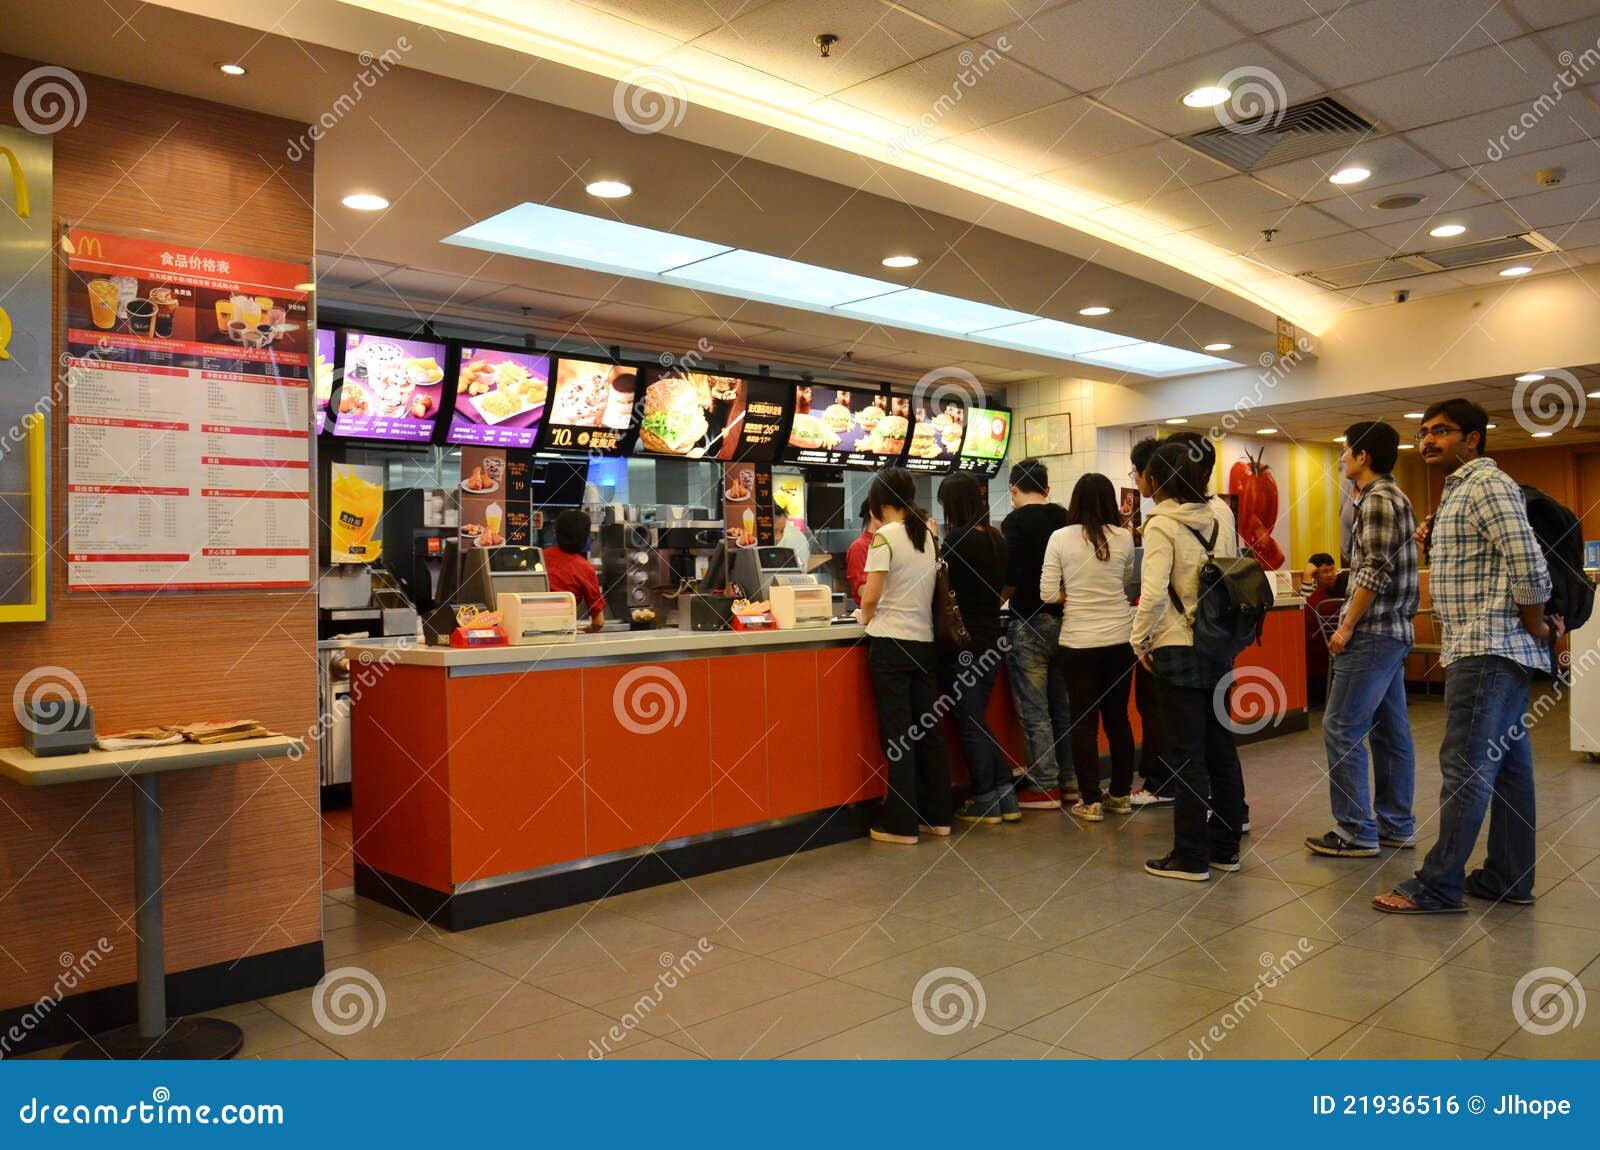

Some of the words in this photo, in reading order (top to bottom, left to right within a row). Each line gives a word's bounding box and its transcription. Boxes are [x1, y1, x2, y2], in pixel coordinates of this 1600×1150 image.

[160, 251, 231, 274] 食品价格表
